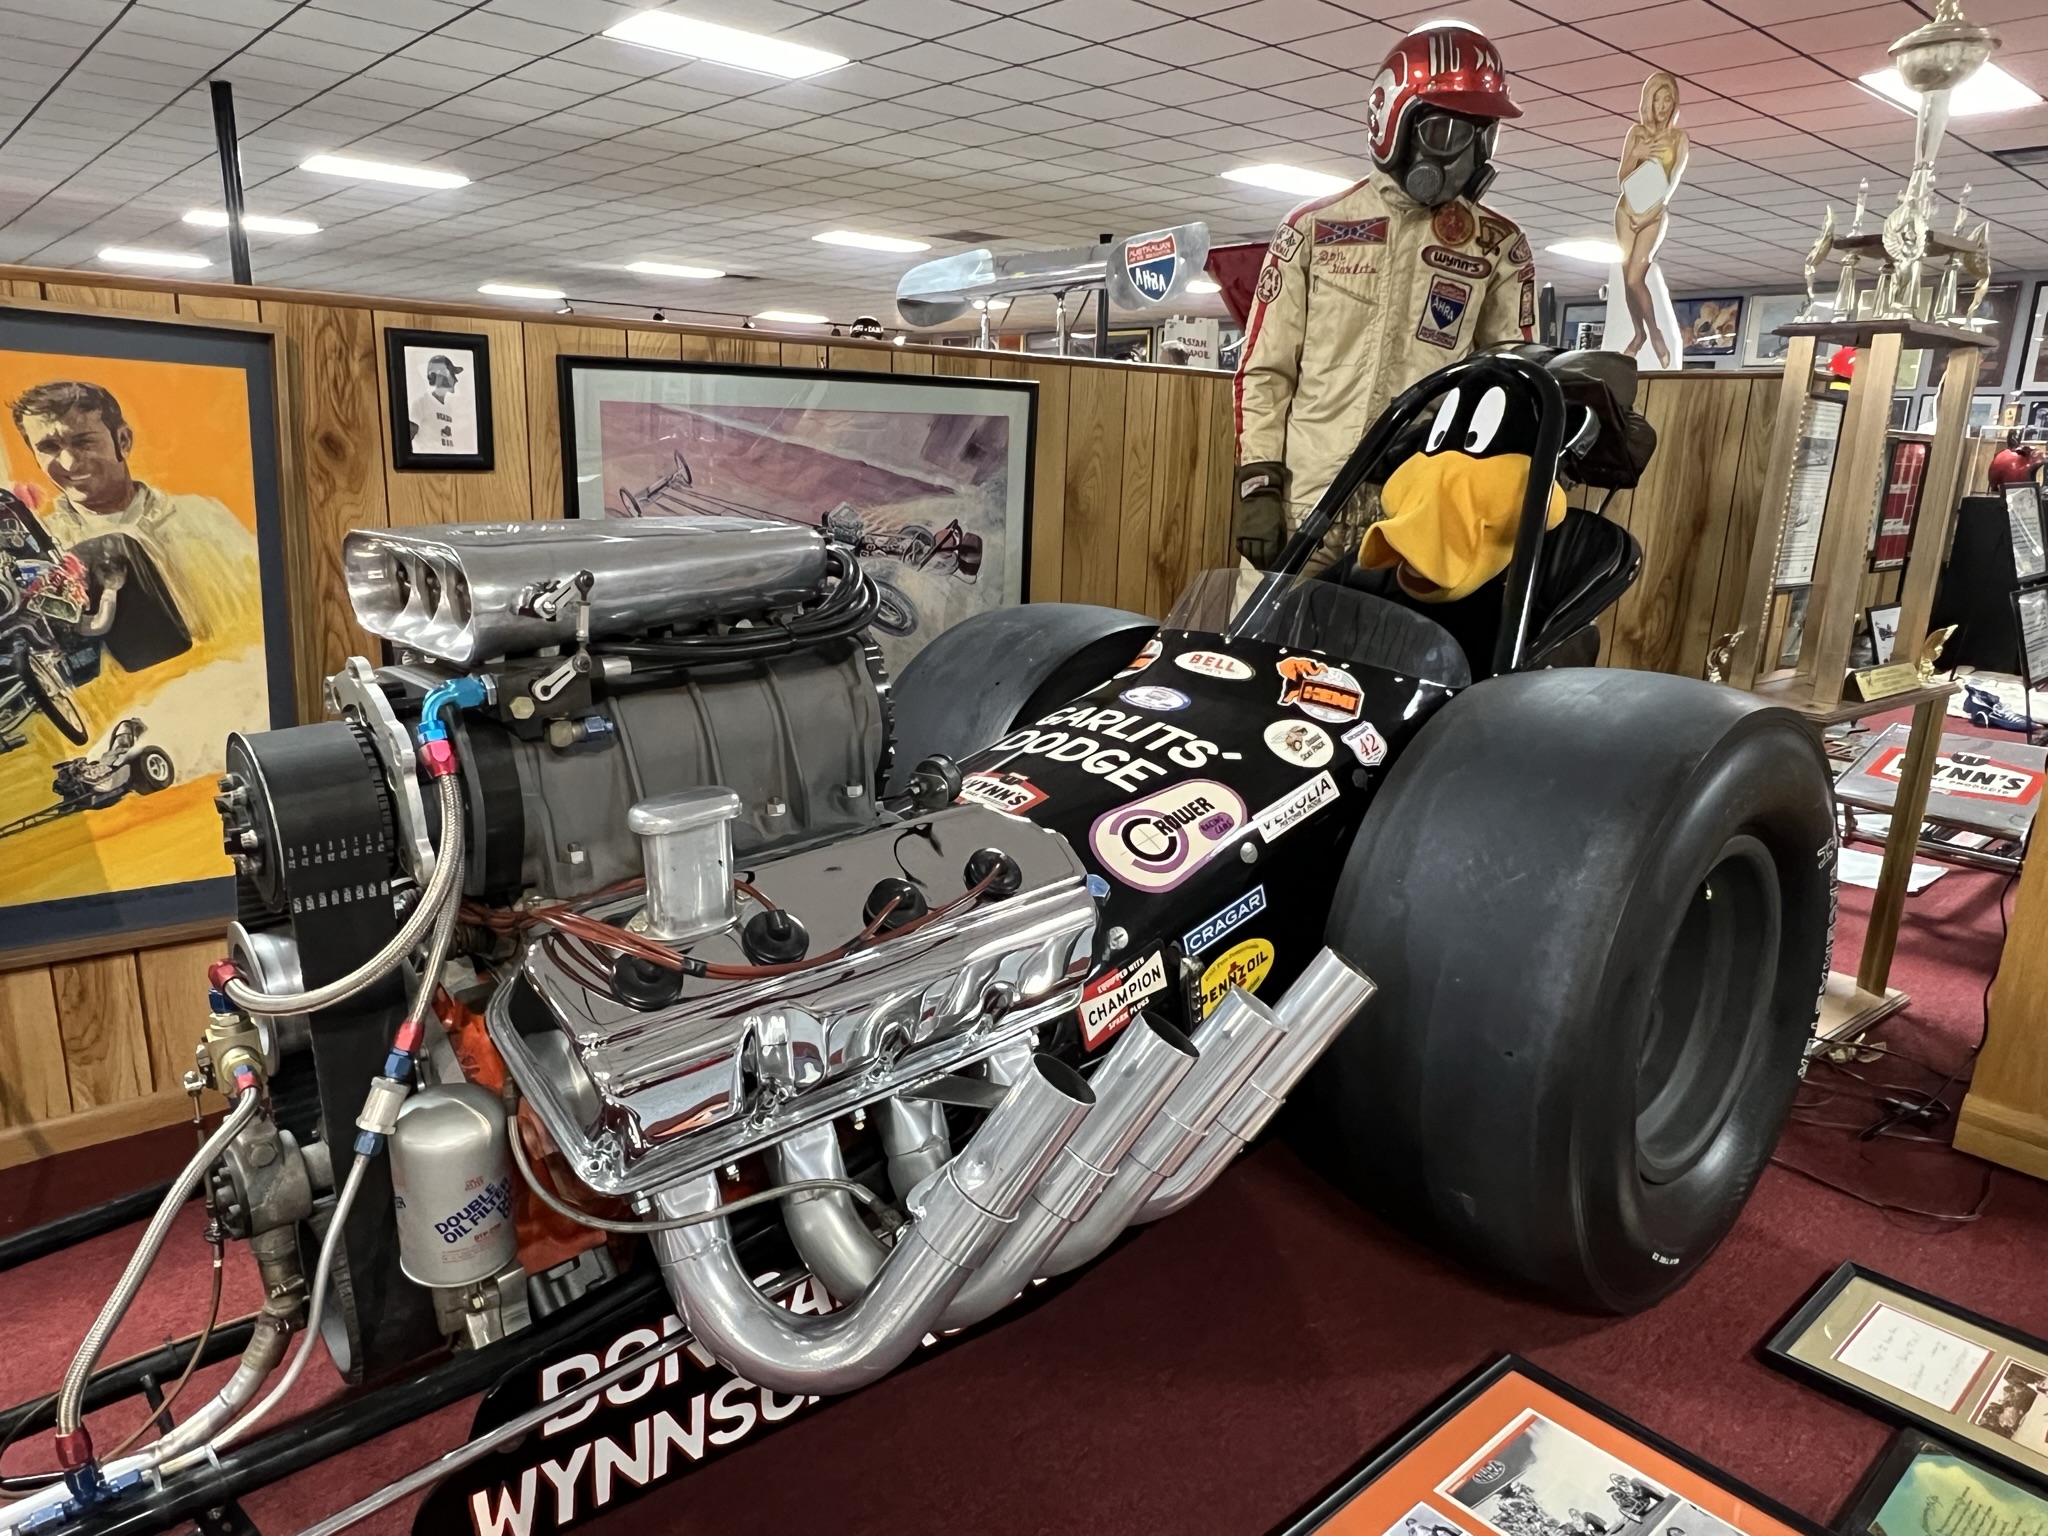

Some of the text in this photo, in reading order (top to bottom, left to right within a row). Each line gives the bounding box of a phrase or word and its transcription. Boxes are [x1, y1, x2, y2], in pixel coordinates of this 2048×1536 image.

[1432, 297, 1454, 321] AHRA
[1189, 654, 1236, 673] BELL
[990, 730, 1168, 793] DODGE
[1360, 734, 1380, 757] 42
[1933, 762, 2026, 791] YNN'S
[1190, 894, 1260, 949] CRAGAR
[1088, 964, 1161, 1027] CHAMPION
[1202, 951, 1269, 1005] PENNZOIL
[434, 1182, 498, 1235] DOUBLE
[443, 1224, 473, 1244] OIL
[469, 1177, 510, 1226] FILTER
